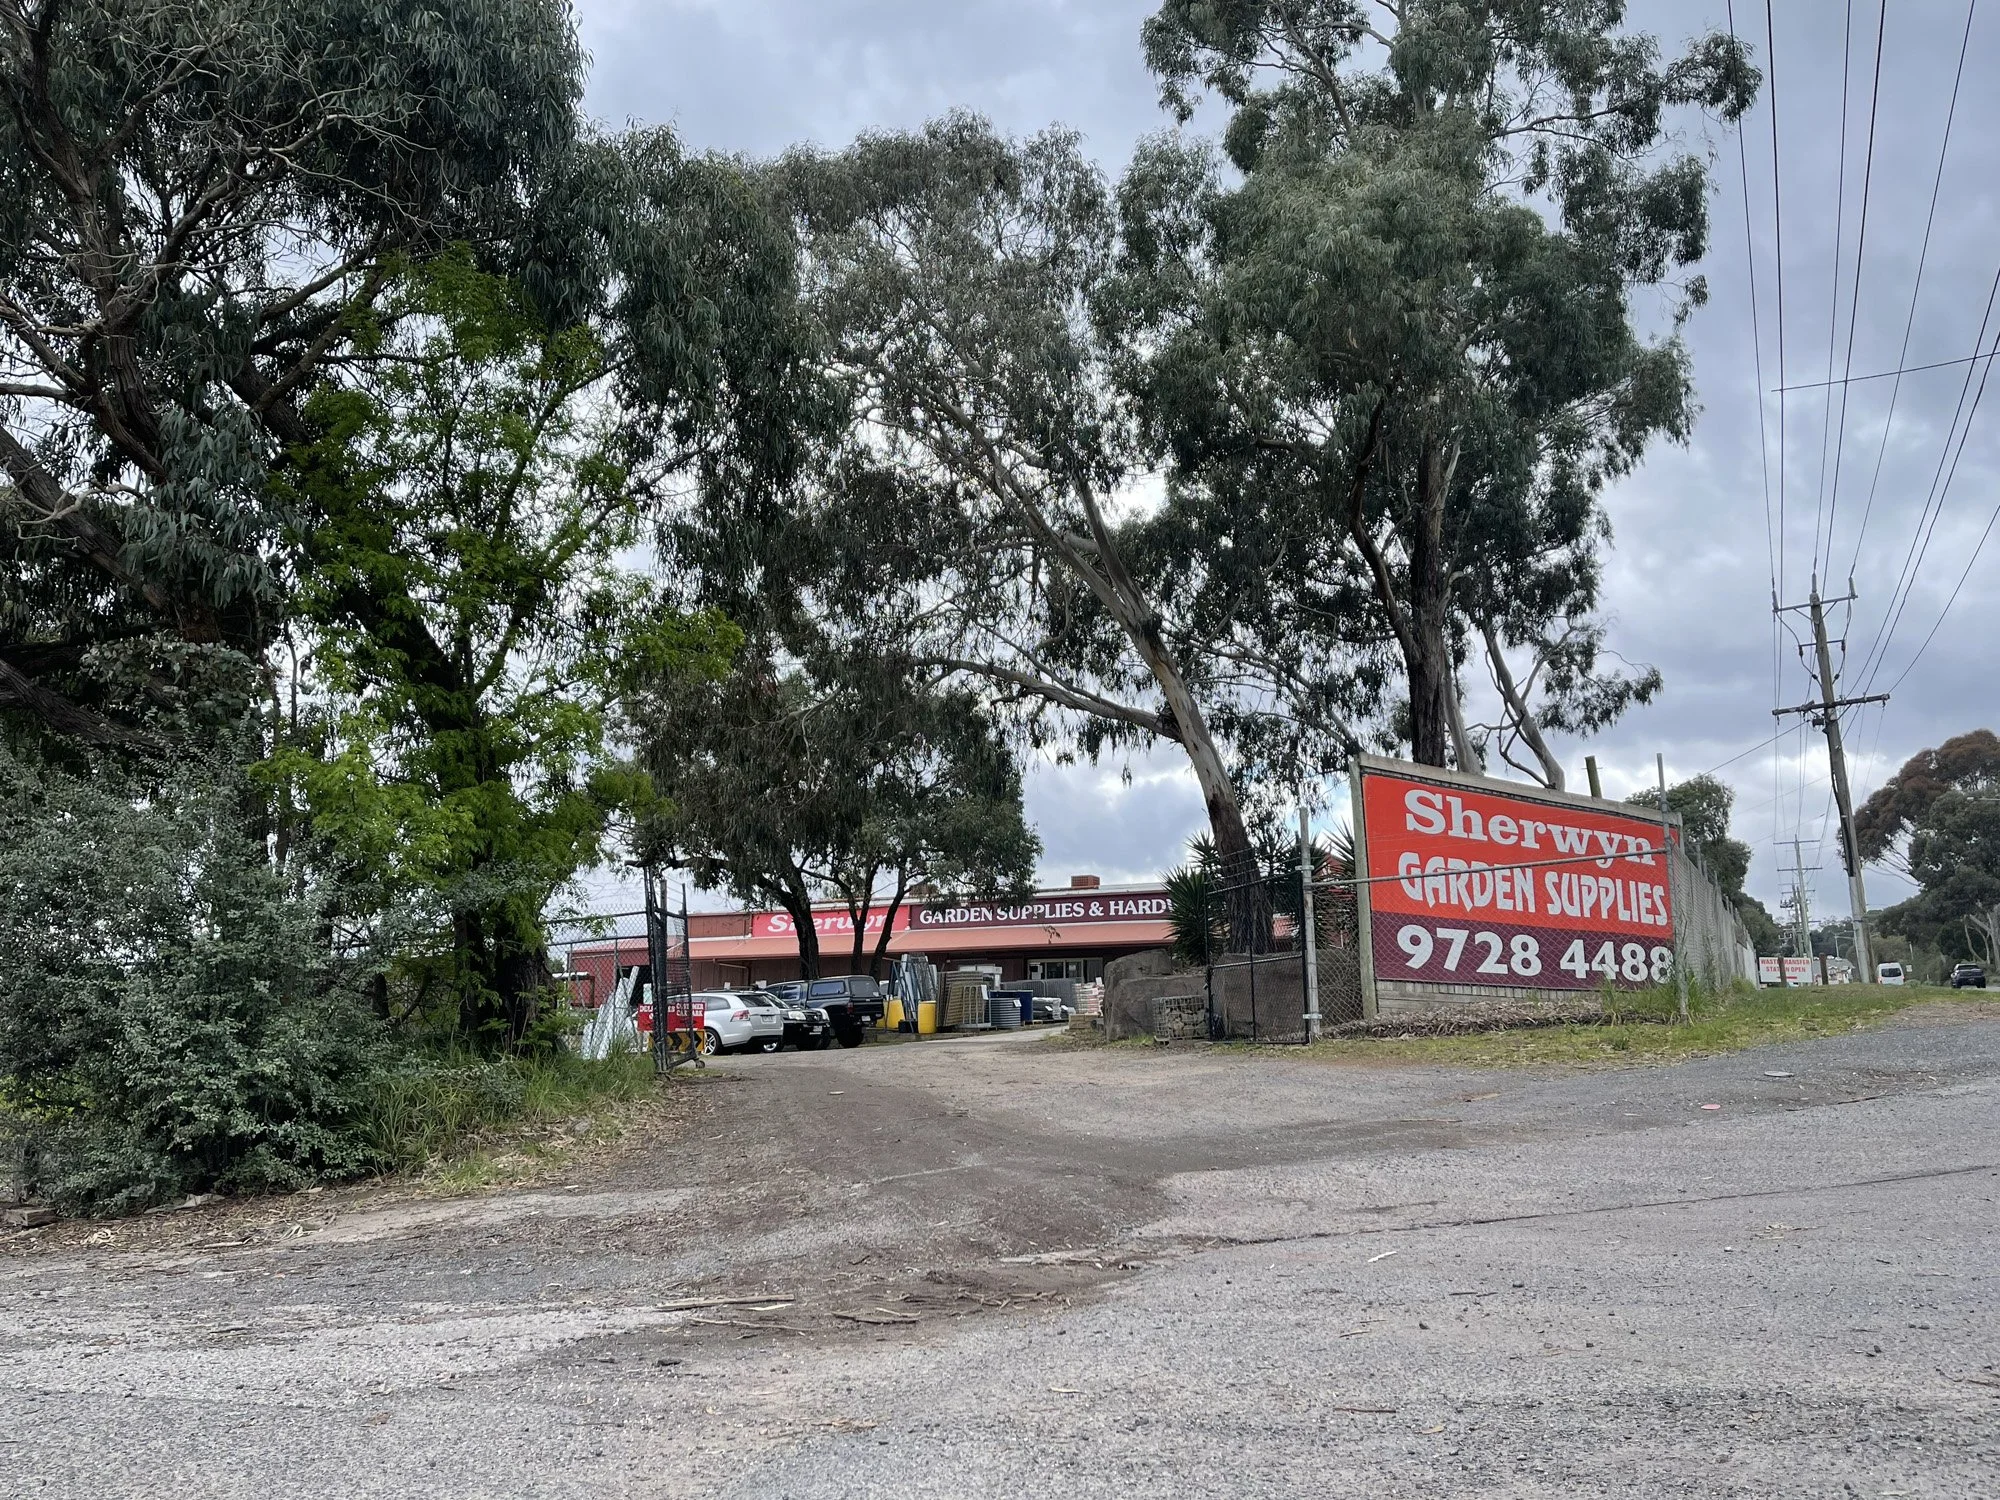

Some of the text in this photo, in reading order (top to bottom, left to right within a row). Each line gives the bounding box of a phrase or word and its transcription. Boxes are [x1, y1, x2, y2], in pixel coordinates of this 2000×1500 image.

[1404, 789, 1656, 868] Sherwyn
[919, 907, 993, 924] GARDEN
[996, 902, 1085, 921] SUPPLIES
[1088, 901, 1104, 916] &
[1398, 851, 1668, 926] GARDEN SUPPLIES
[1397, 924, 1674, 984] 9728 4488
